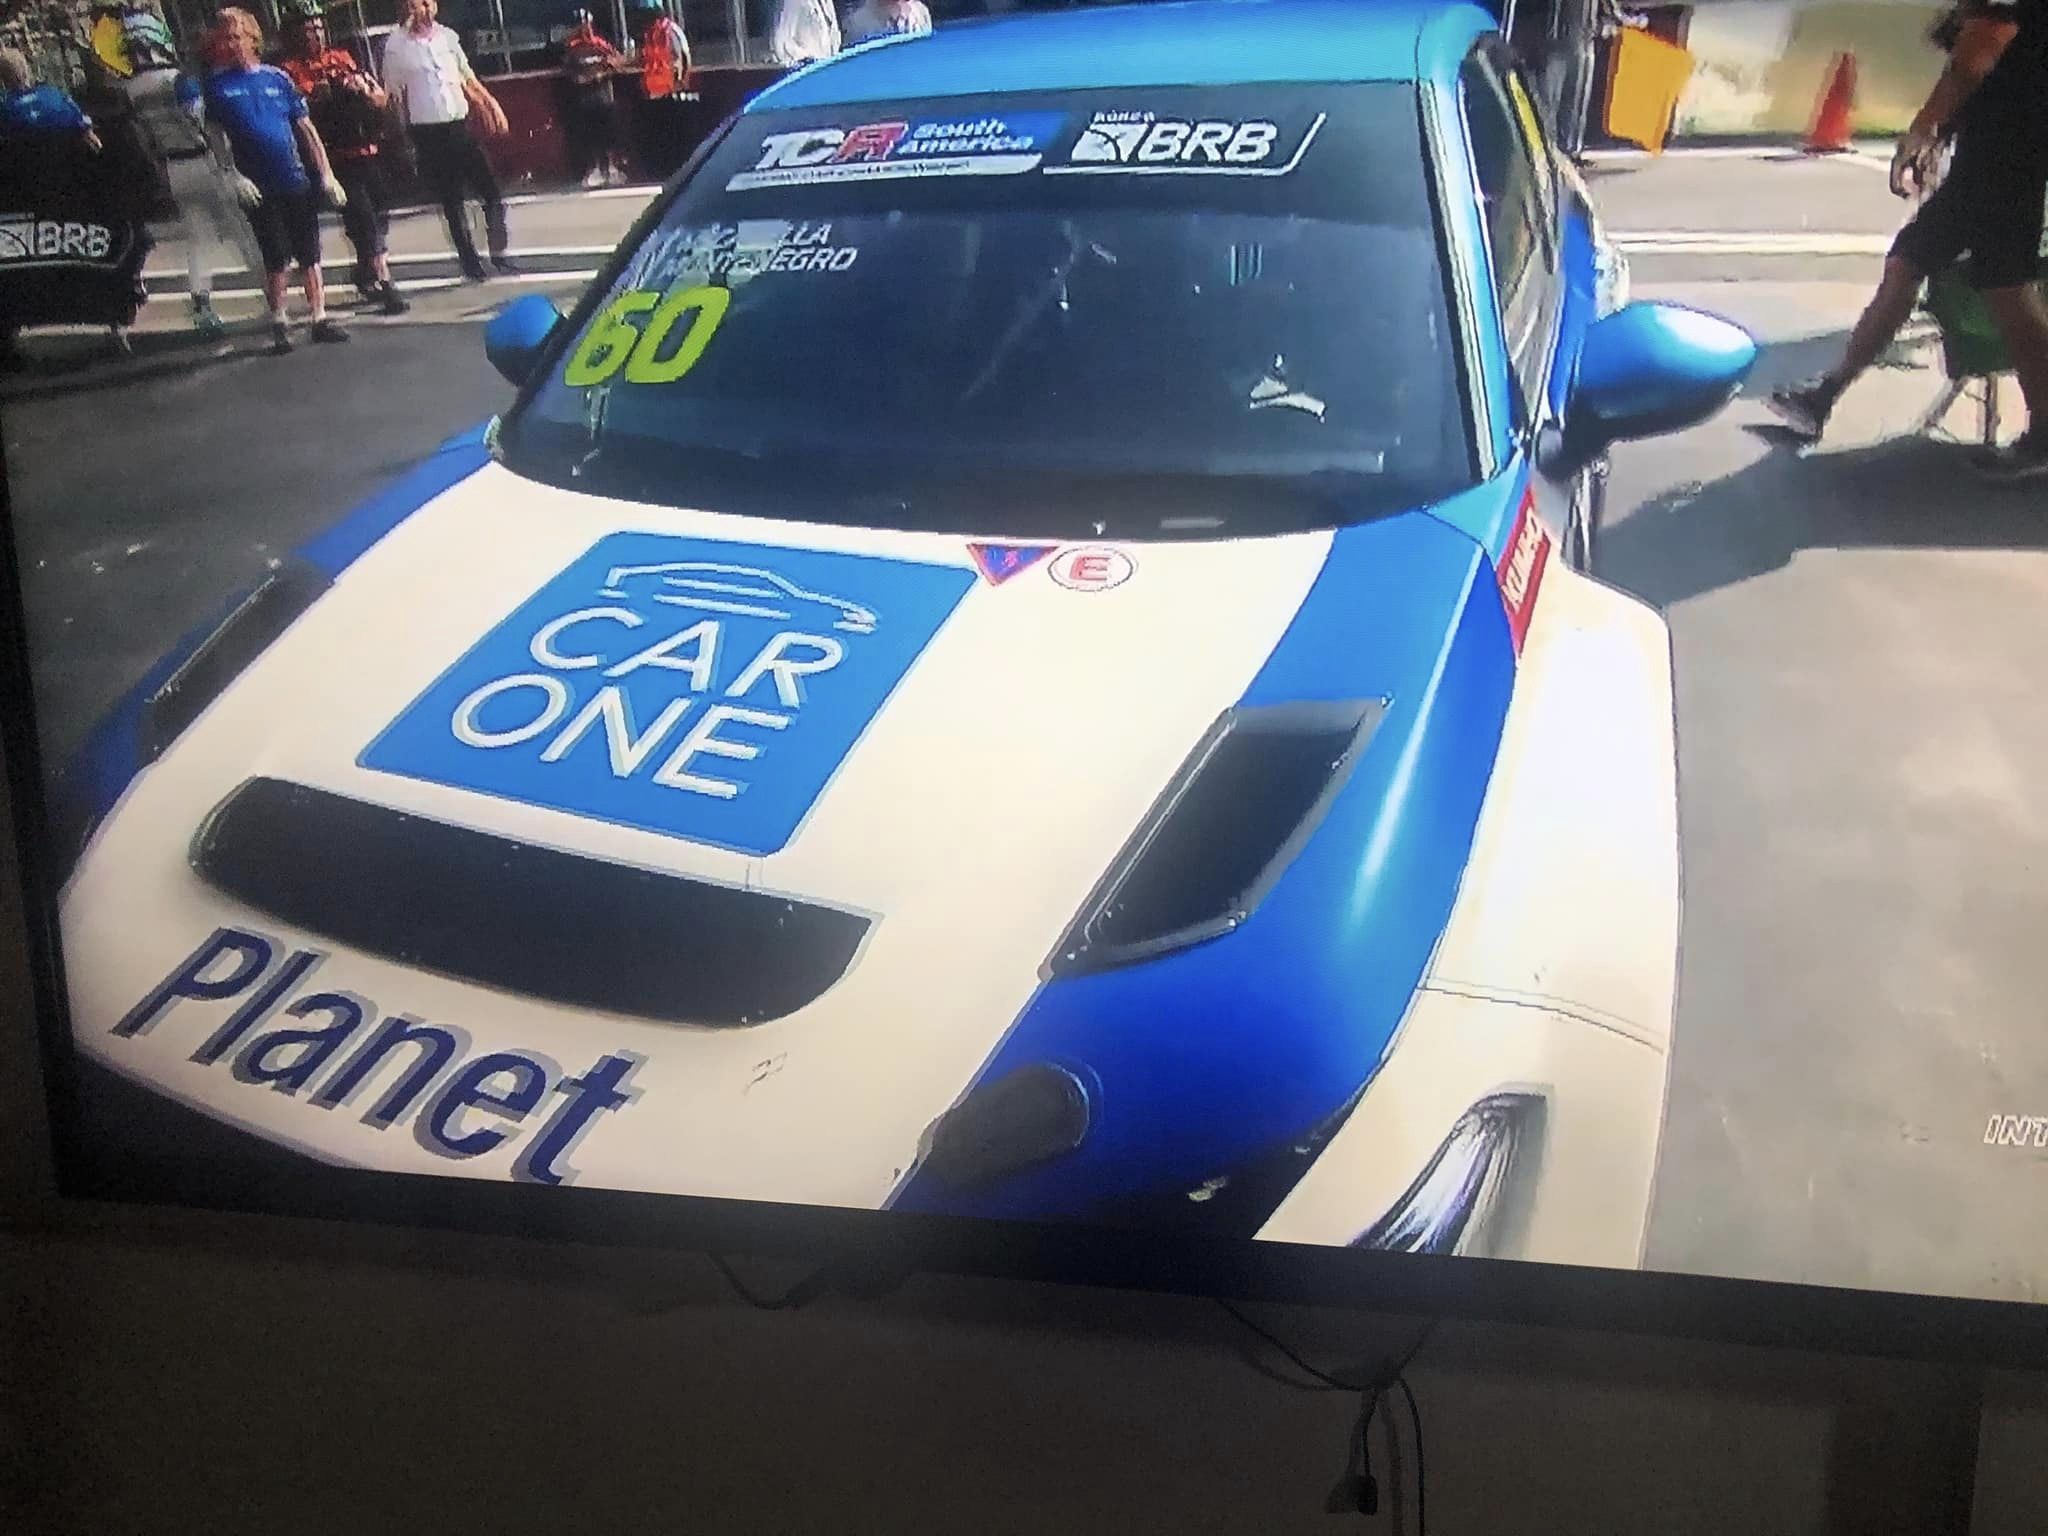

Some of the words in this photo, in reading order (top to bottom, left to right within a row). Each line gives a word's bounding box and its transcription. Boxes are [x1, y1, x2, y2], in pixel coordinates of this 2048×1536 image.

[1138, 122, 1277, 162] BRB
[38, 221, 111, 257] BRB
[564, 286, 730, 387] 60
[529, 606, 845, 708] CAR
[451, 673, 791, 800] ONE
[108, 926, 648, 1186] Planet
